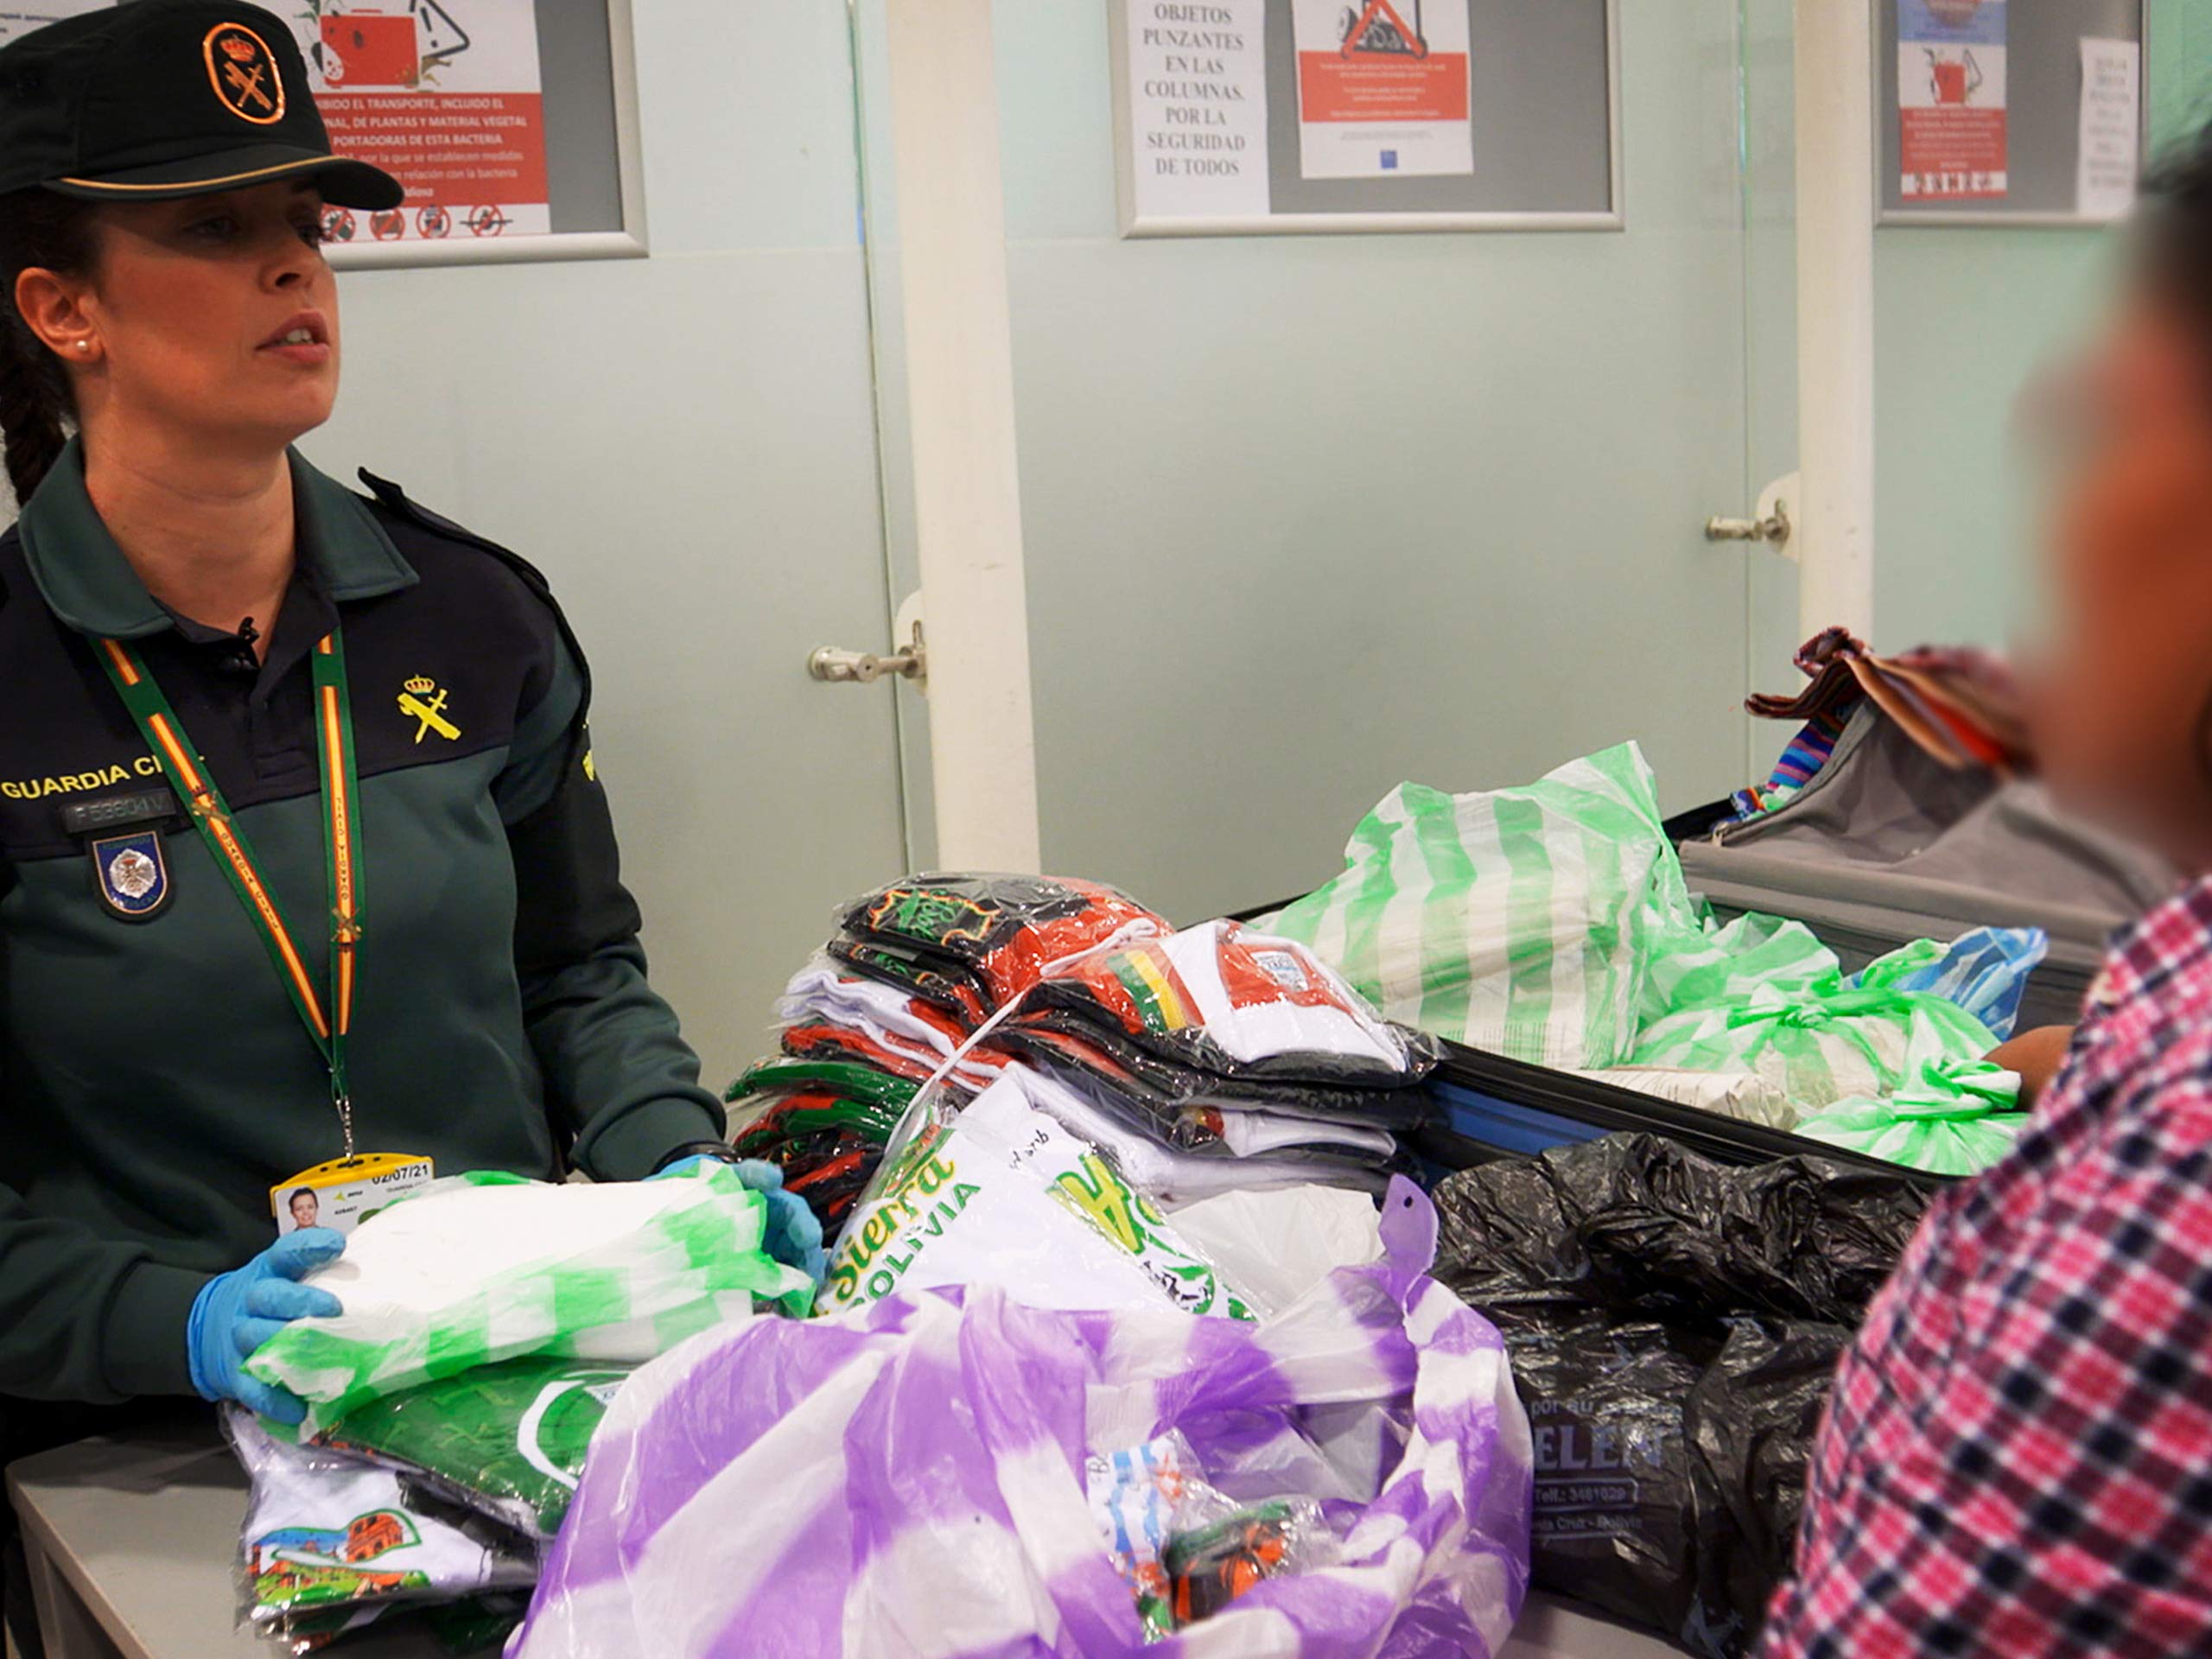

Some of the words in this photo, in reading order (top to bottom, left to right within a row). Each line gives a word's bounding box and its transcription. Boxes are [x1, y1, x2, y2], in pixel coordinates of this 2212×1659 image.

[1154, 3, 1232, 24] OBJETOS
[1143, 29, 1243, 51] PUNZANTES
[1165, 55, 1188, 73] EN
[1192, 57, 1225, 75] LAS
[353, 99, 365, 110] EL
[441, 98, 491, 110] INCLUIDO
[493, 98, 505, 110] EL
[353, 117, 366, 129] DE
[370, 117, 417, 128] PLANTAS
[419, 117, 428, 127] Y
[429, 116, 481, 127] MATERIAL
[482, 116, 528, 127] VEGETAL
[1166, 106, 1200, 125] POR
[1205, 108, 1227, 126] LA
[333, 135, 407, 147] PORTADORAS
[409, 135, 423, 146] DE
[425, 135, 450, 145] ESTA
[452, 134, 504, 145] BACTERIA
[1147, 132, 1246, 151] SEGURIDAD
[1155, 156, 1179, 175] DE
[1185, 158, 1240, 176] TODOS
[1, 765, 131, 799] GUARDIA
